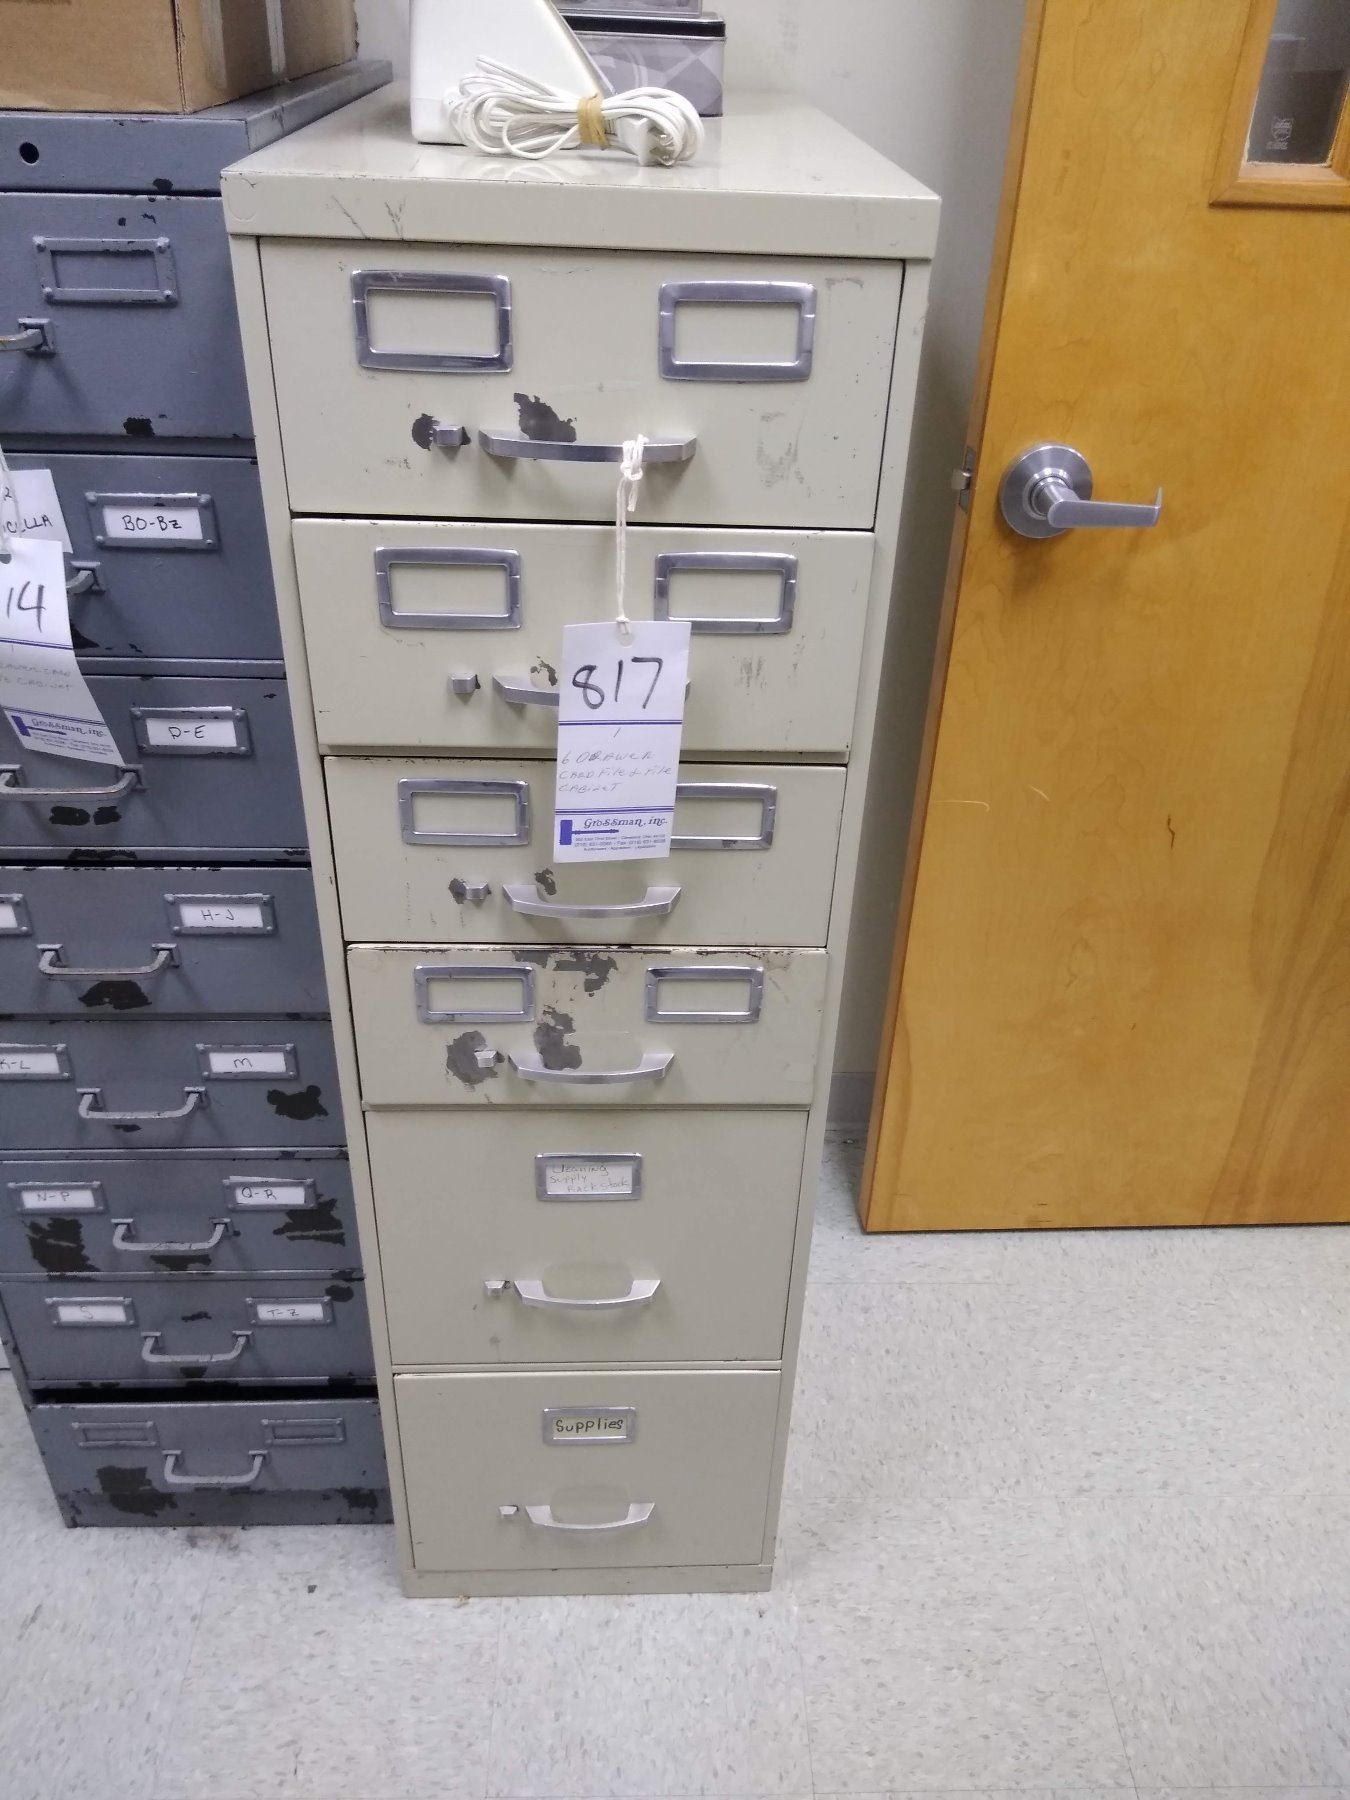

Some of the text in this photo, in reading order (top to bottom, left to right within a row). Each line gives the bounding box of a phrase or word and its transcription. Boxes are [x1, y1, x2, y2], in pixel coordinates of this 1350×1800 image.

[571, 656, 664, 710] 817
[168, 724, 206, 740] D-E
[200, 908, 235, 921] H-J
[241, 1186, 277, 1201] Q-R
[555, 1417, 624, 1433] Supplies
